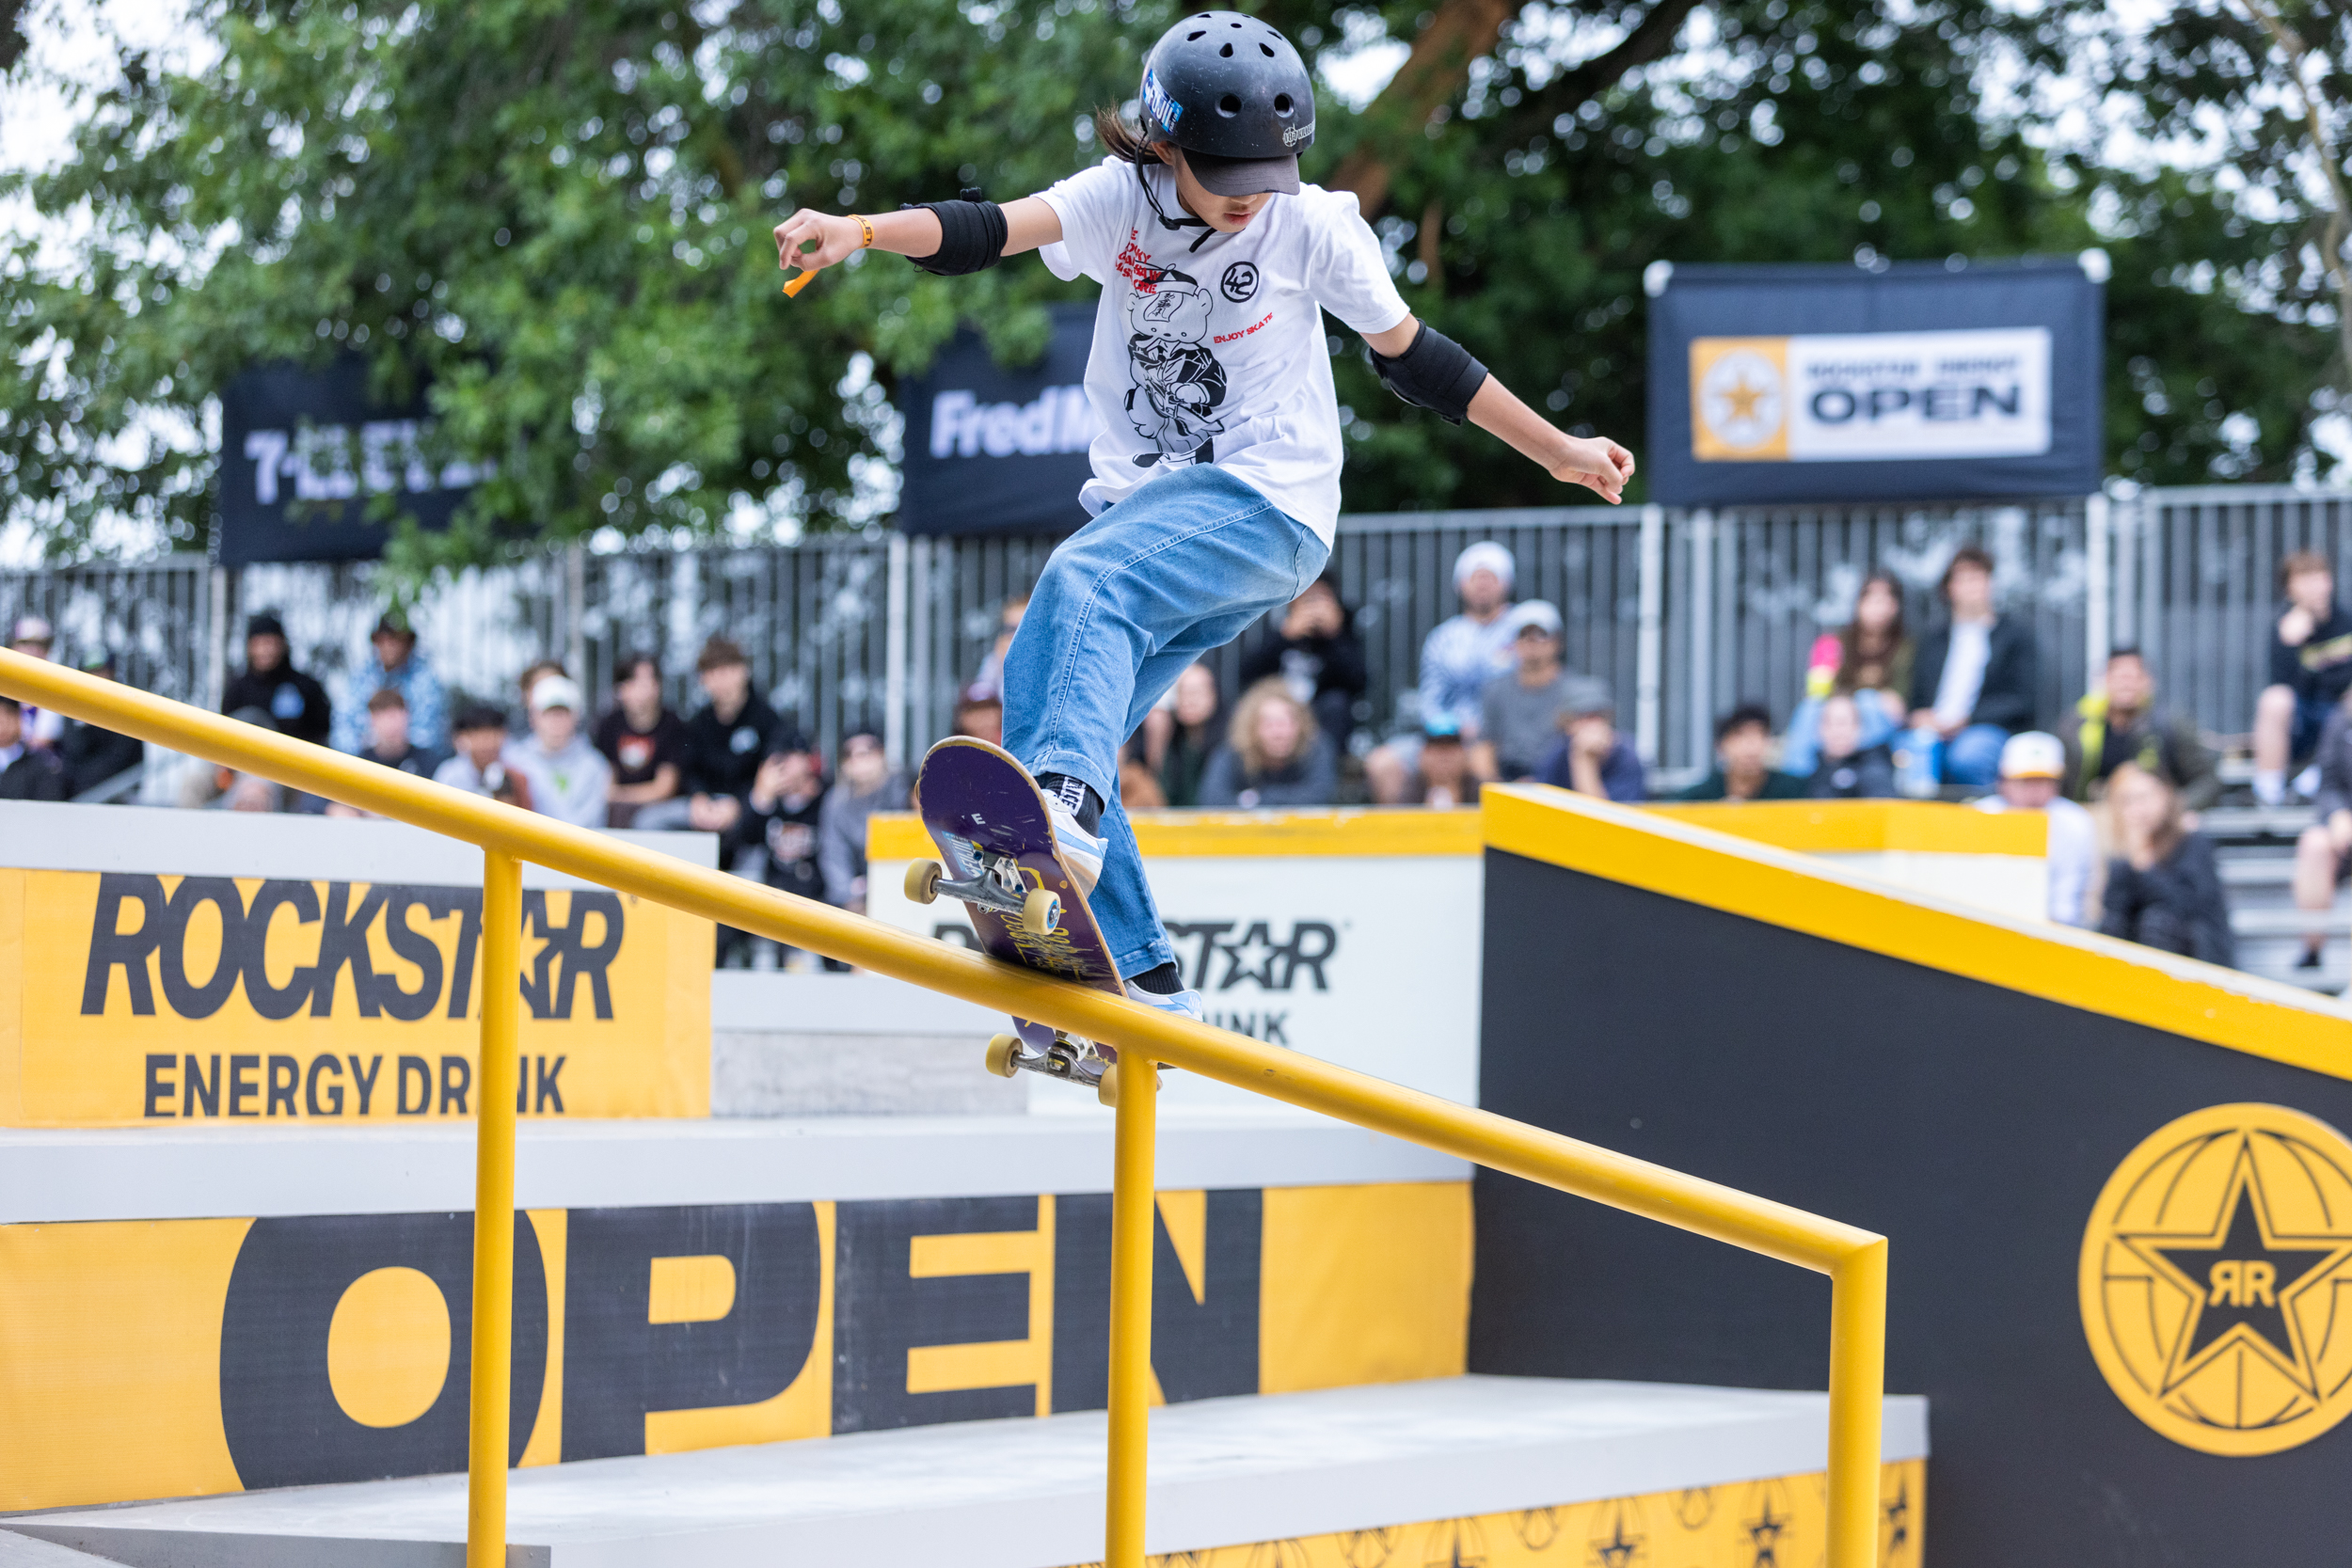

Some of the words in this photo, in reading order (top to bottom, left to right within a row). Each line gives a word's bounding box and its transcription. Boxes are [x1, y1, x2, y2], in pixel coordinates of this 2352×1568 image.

[1224, 267, 1254, 295] 42
[1214, 330, 1245, 343] ENJOY
[1247, 312, 1273, 335] SKATE
[1810, 383, 2019, 424] OPEN
[144, 1053, 383, 1117] ENERGY
[398, 1053, 566, 1115] DRK
[219, 1188, 1263, 1491] OPEN
